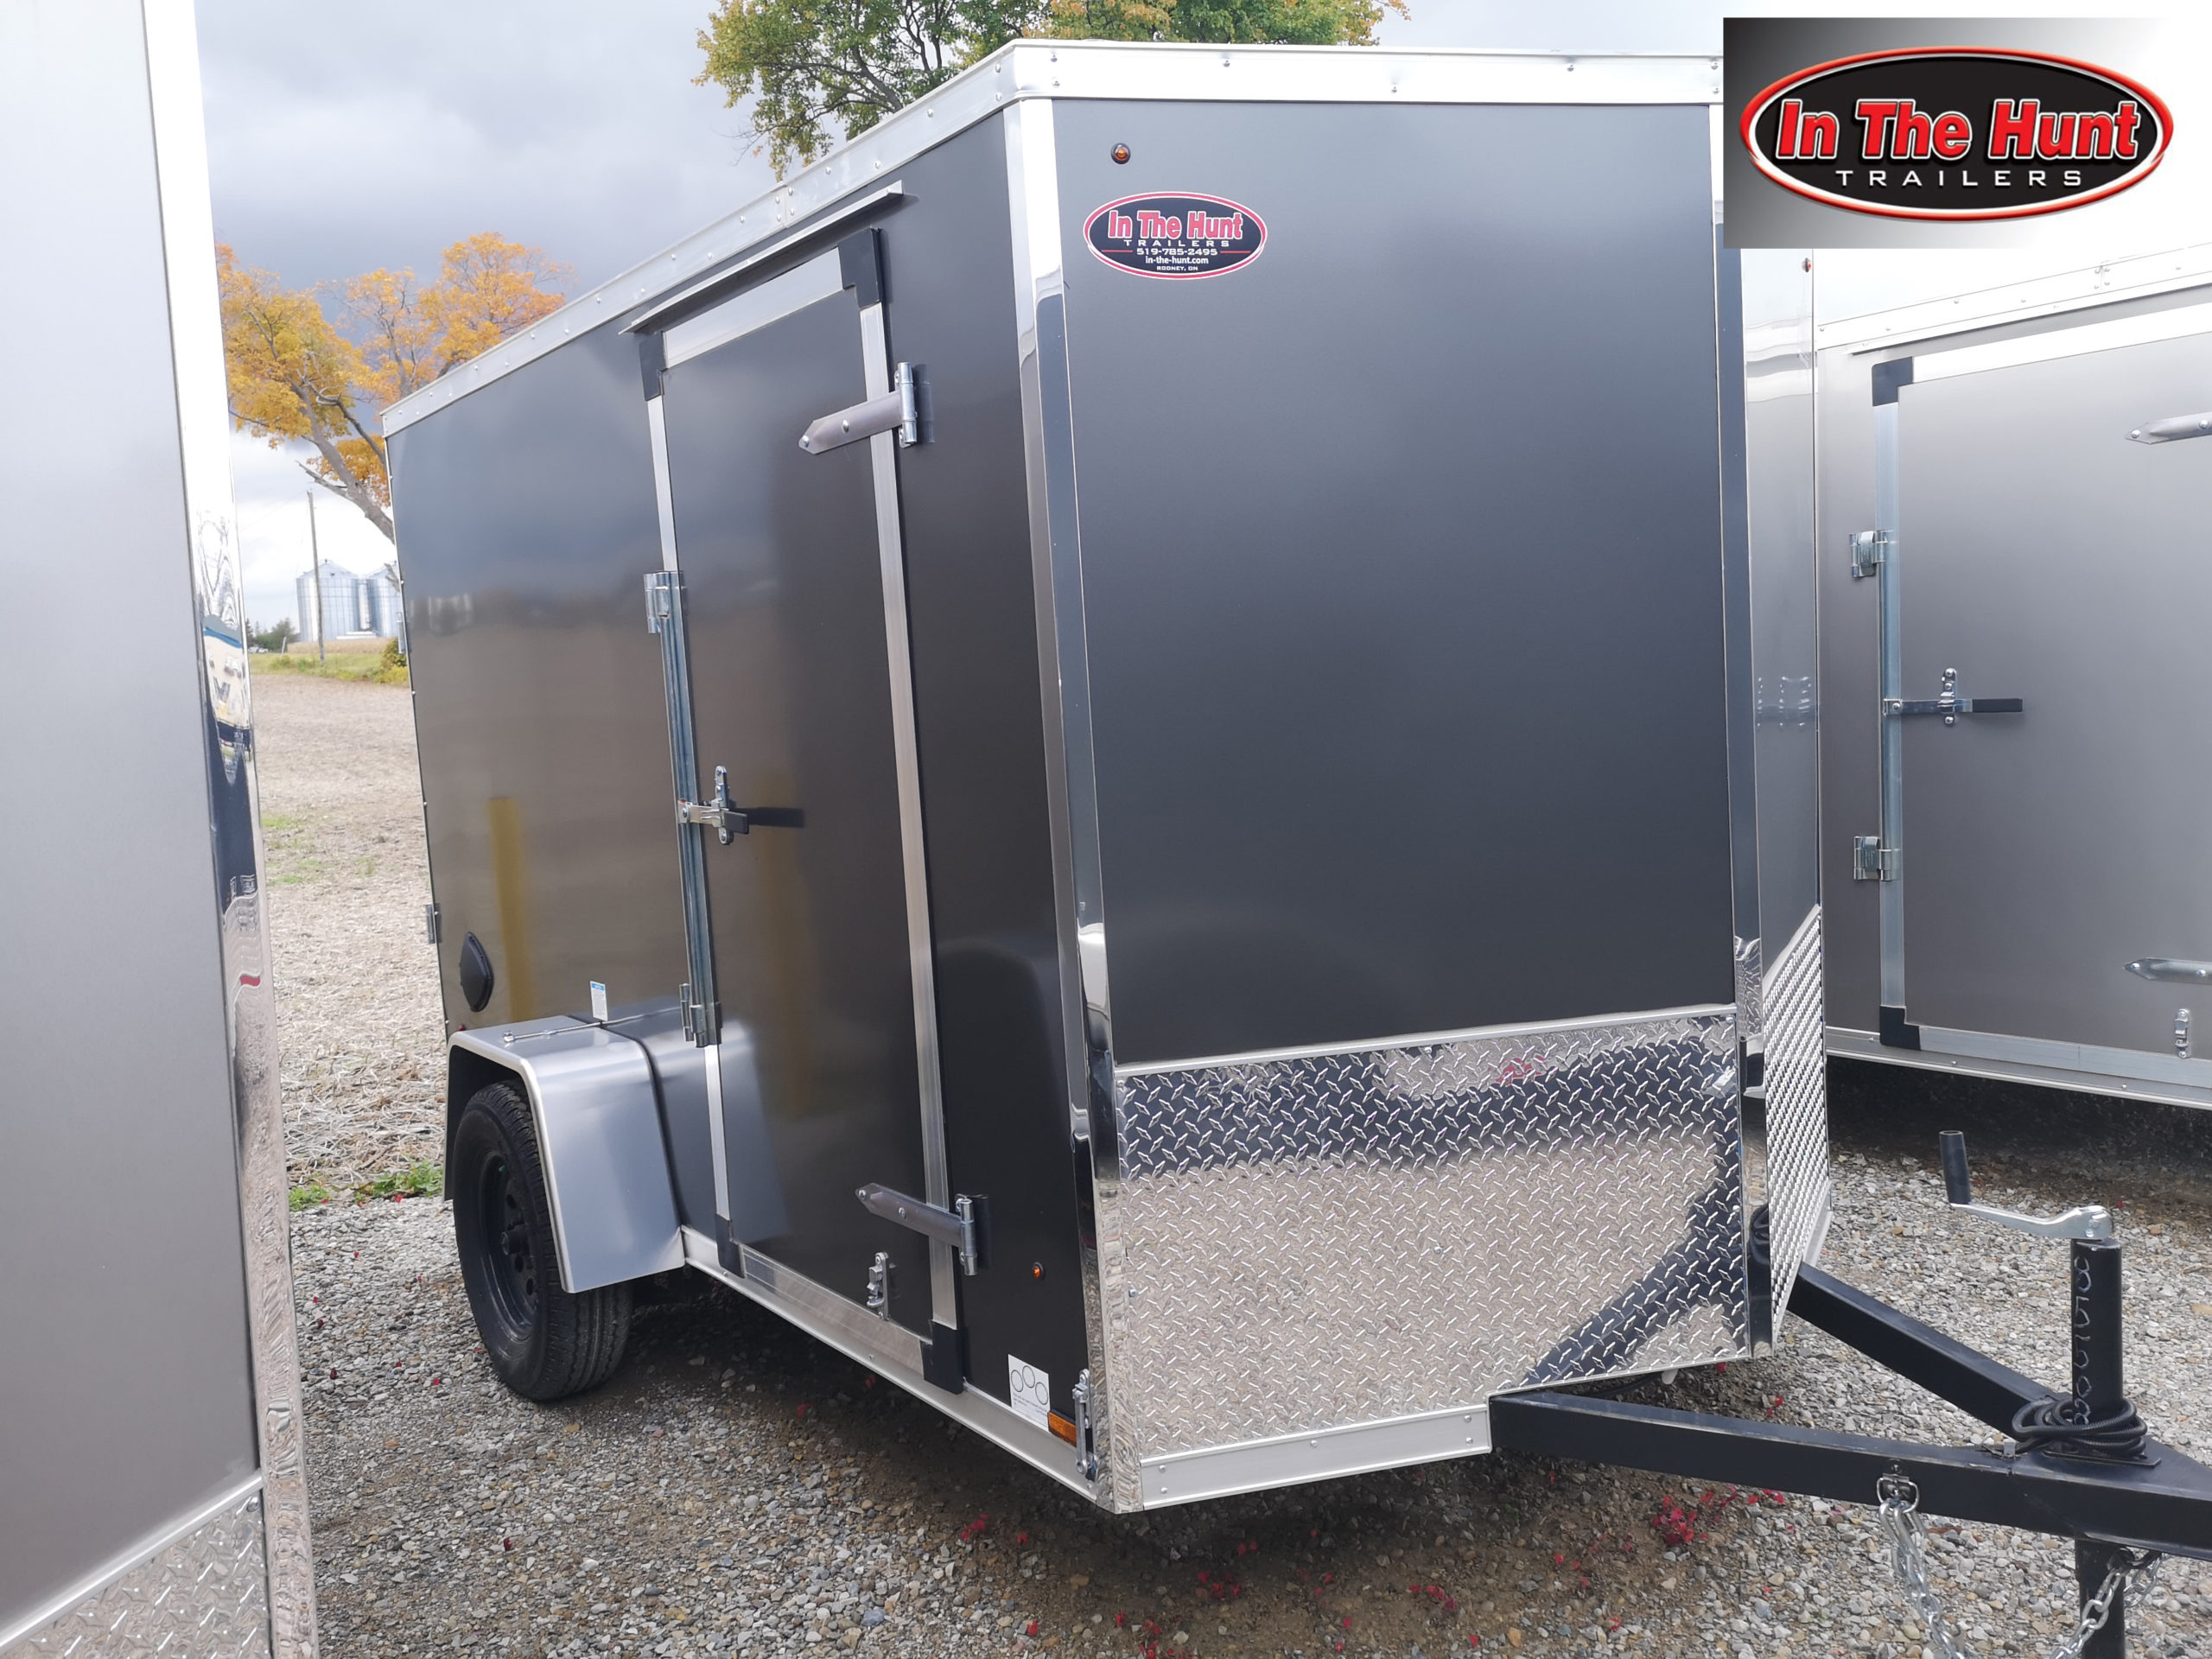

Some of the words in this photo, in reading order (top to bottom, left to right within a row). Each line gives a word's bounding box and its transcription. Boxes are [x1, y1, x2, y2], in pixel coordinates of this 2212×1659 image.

[1108, 210, 1133, 238] In
[1137, 210, 1182, 239] The
[1186, 211, 1243, 239] Hunt
[1145, 256, 1209, 264] in-the-hunt.com
